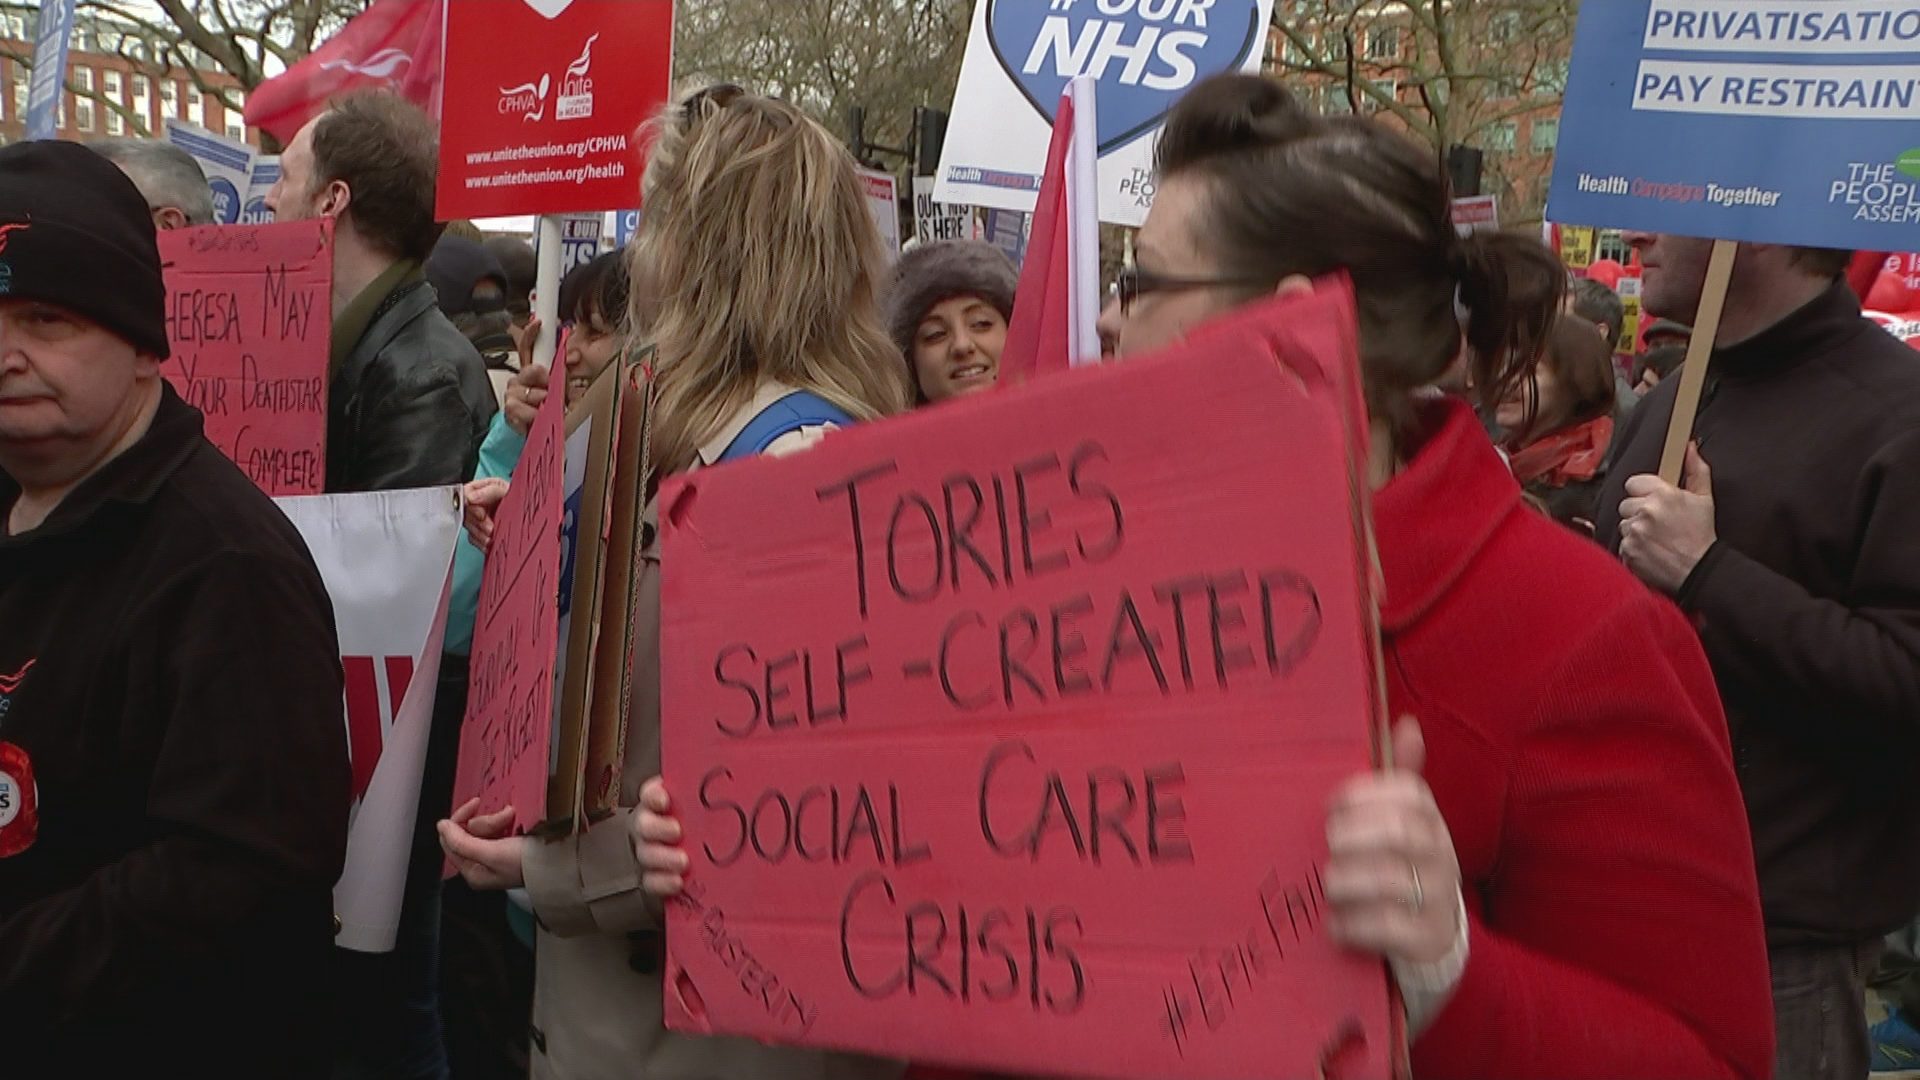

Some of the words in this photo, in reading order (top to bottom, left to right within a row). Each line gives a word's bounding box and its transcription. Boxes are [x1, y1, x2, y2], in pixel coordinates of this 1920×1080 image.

[1650, 9, 1920, 42] PRIVATISATIO
[1022, 15, 1209, 90] NHS
[498, 95, 536, 114] CPHVA
[1639, 73, 1713, 102] PAY
[1720, 77, 1920, 109] RESTRAIN
[466, 135, 627, 165] www.unitetheunion.org/CPHVA
[465, 161, 625, 189] www.unitetheunion.org/health
[947, 165, 981, 182] Health
[1848, 163, 1895, 184] THE
[1578, 173, 1629, 195] Health
[1707, 184, 1781, 207] Together
[1829, 181, 1920, 206] PEOPL
[917, 193, 943, 219] OUR
[1853, 204, 1920, 224] ASSEM
[919, 219, 930, 242] IS
[933, 217, 964, 240] HERE
[166, 288, 242, 348] HERESA
[262, 262, 314, 341] MAY
[178, 353, 229, 417] YOUR
[241, 354, 324, 415] DEATHSTAR
[815, 439, 1126, 622] TORIES
[698, 765, 933, 869] SOCIAL
[977, 738, 1195, 868] CARE
[840, 870, 1087, 1016] CRISIS
